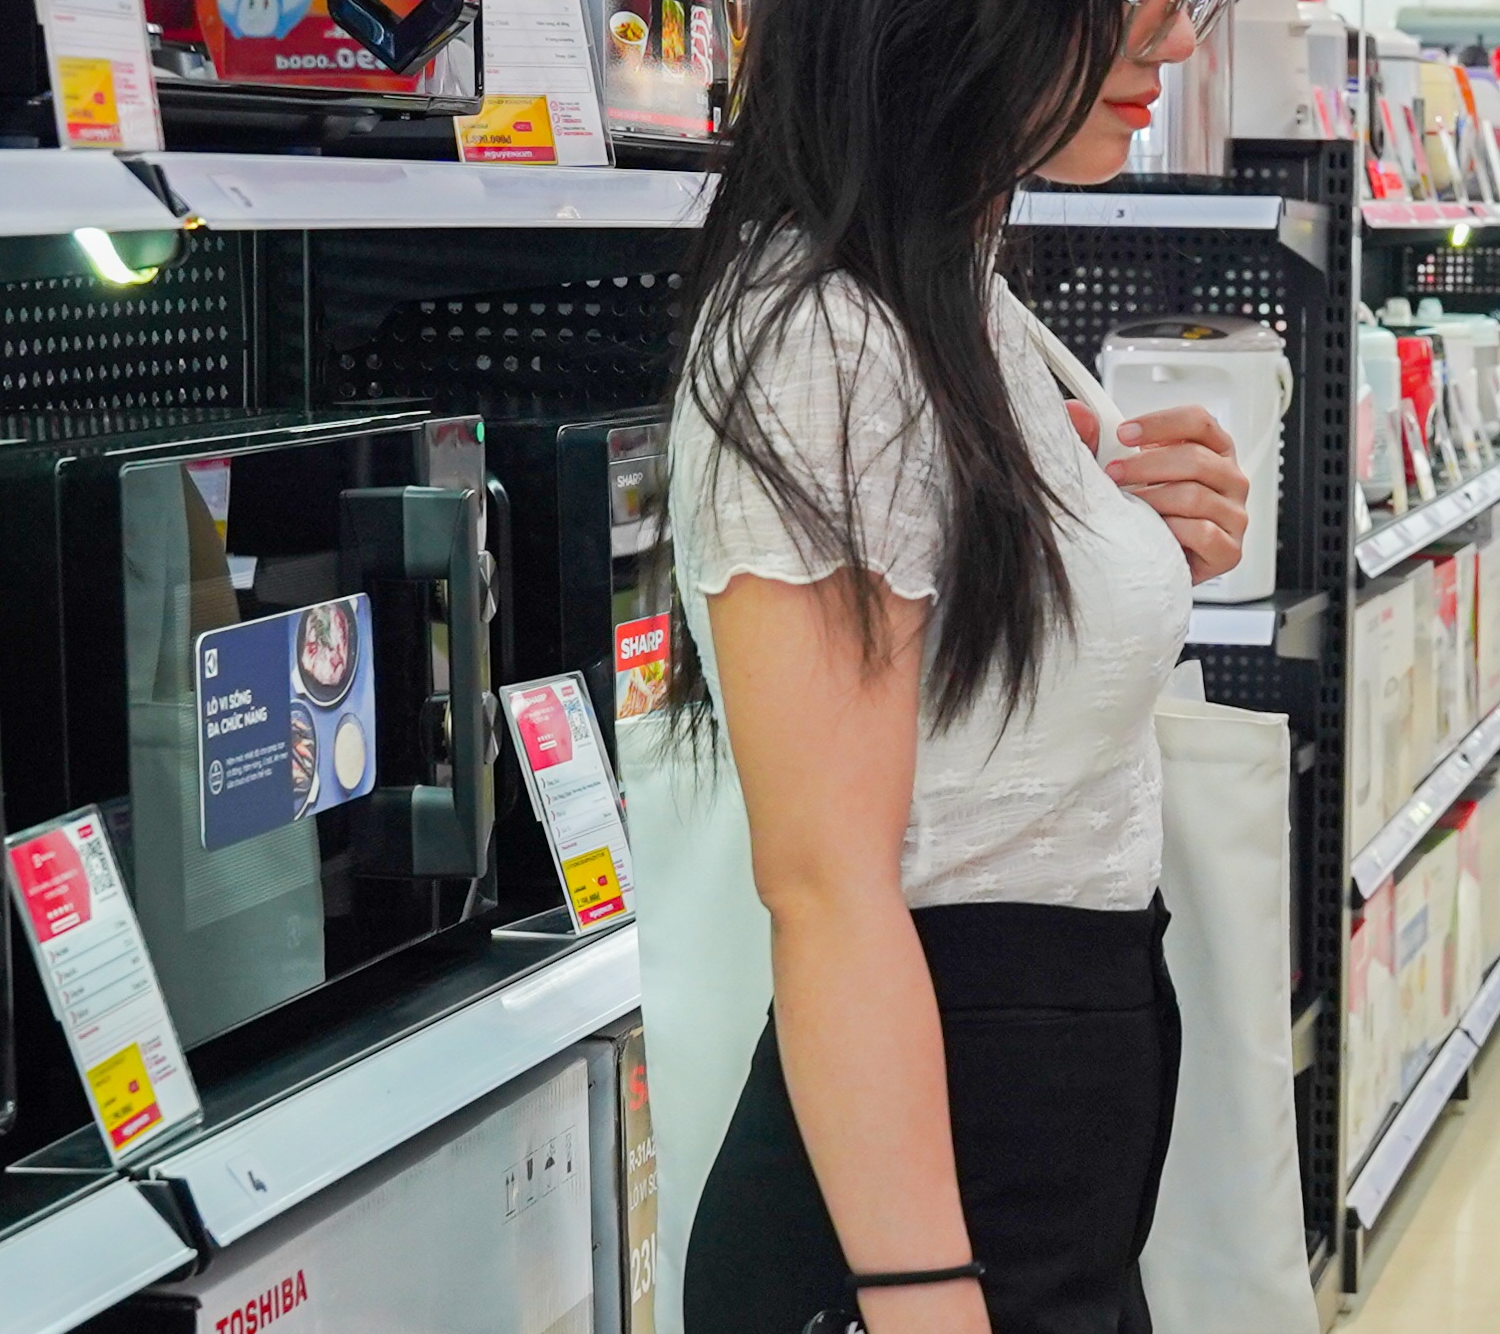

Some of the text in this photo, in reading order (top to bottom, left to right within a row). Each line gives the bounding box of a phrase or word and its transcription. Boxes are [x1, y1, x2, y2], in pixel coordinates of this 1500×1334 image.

[621, 628, 663, 660] SHARP
[206, 689, 252, 716] LÒ VI SÓNG
[207, 718, 220, 738] ĐA
